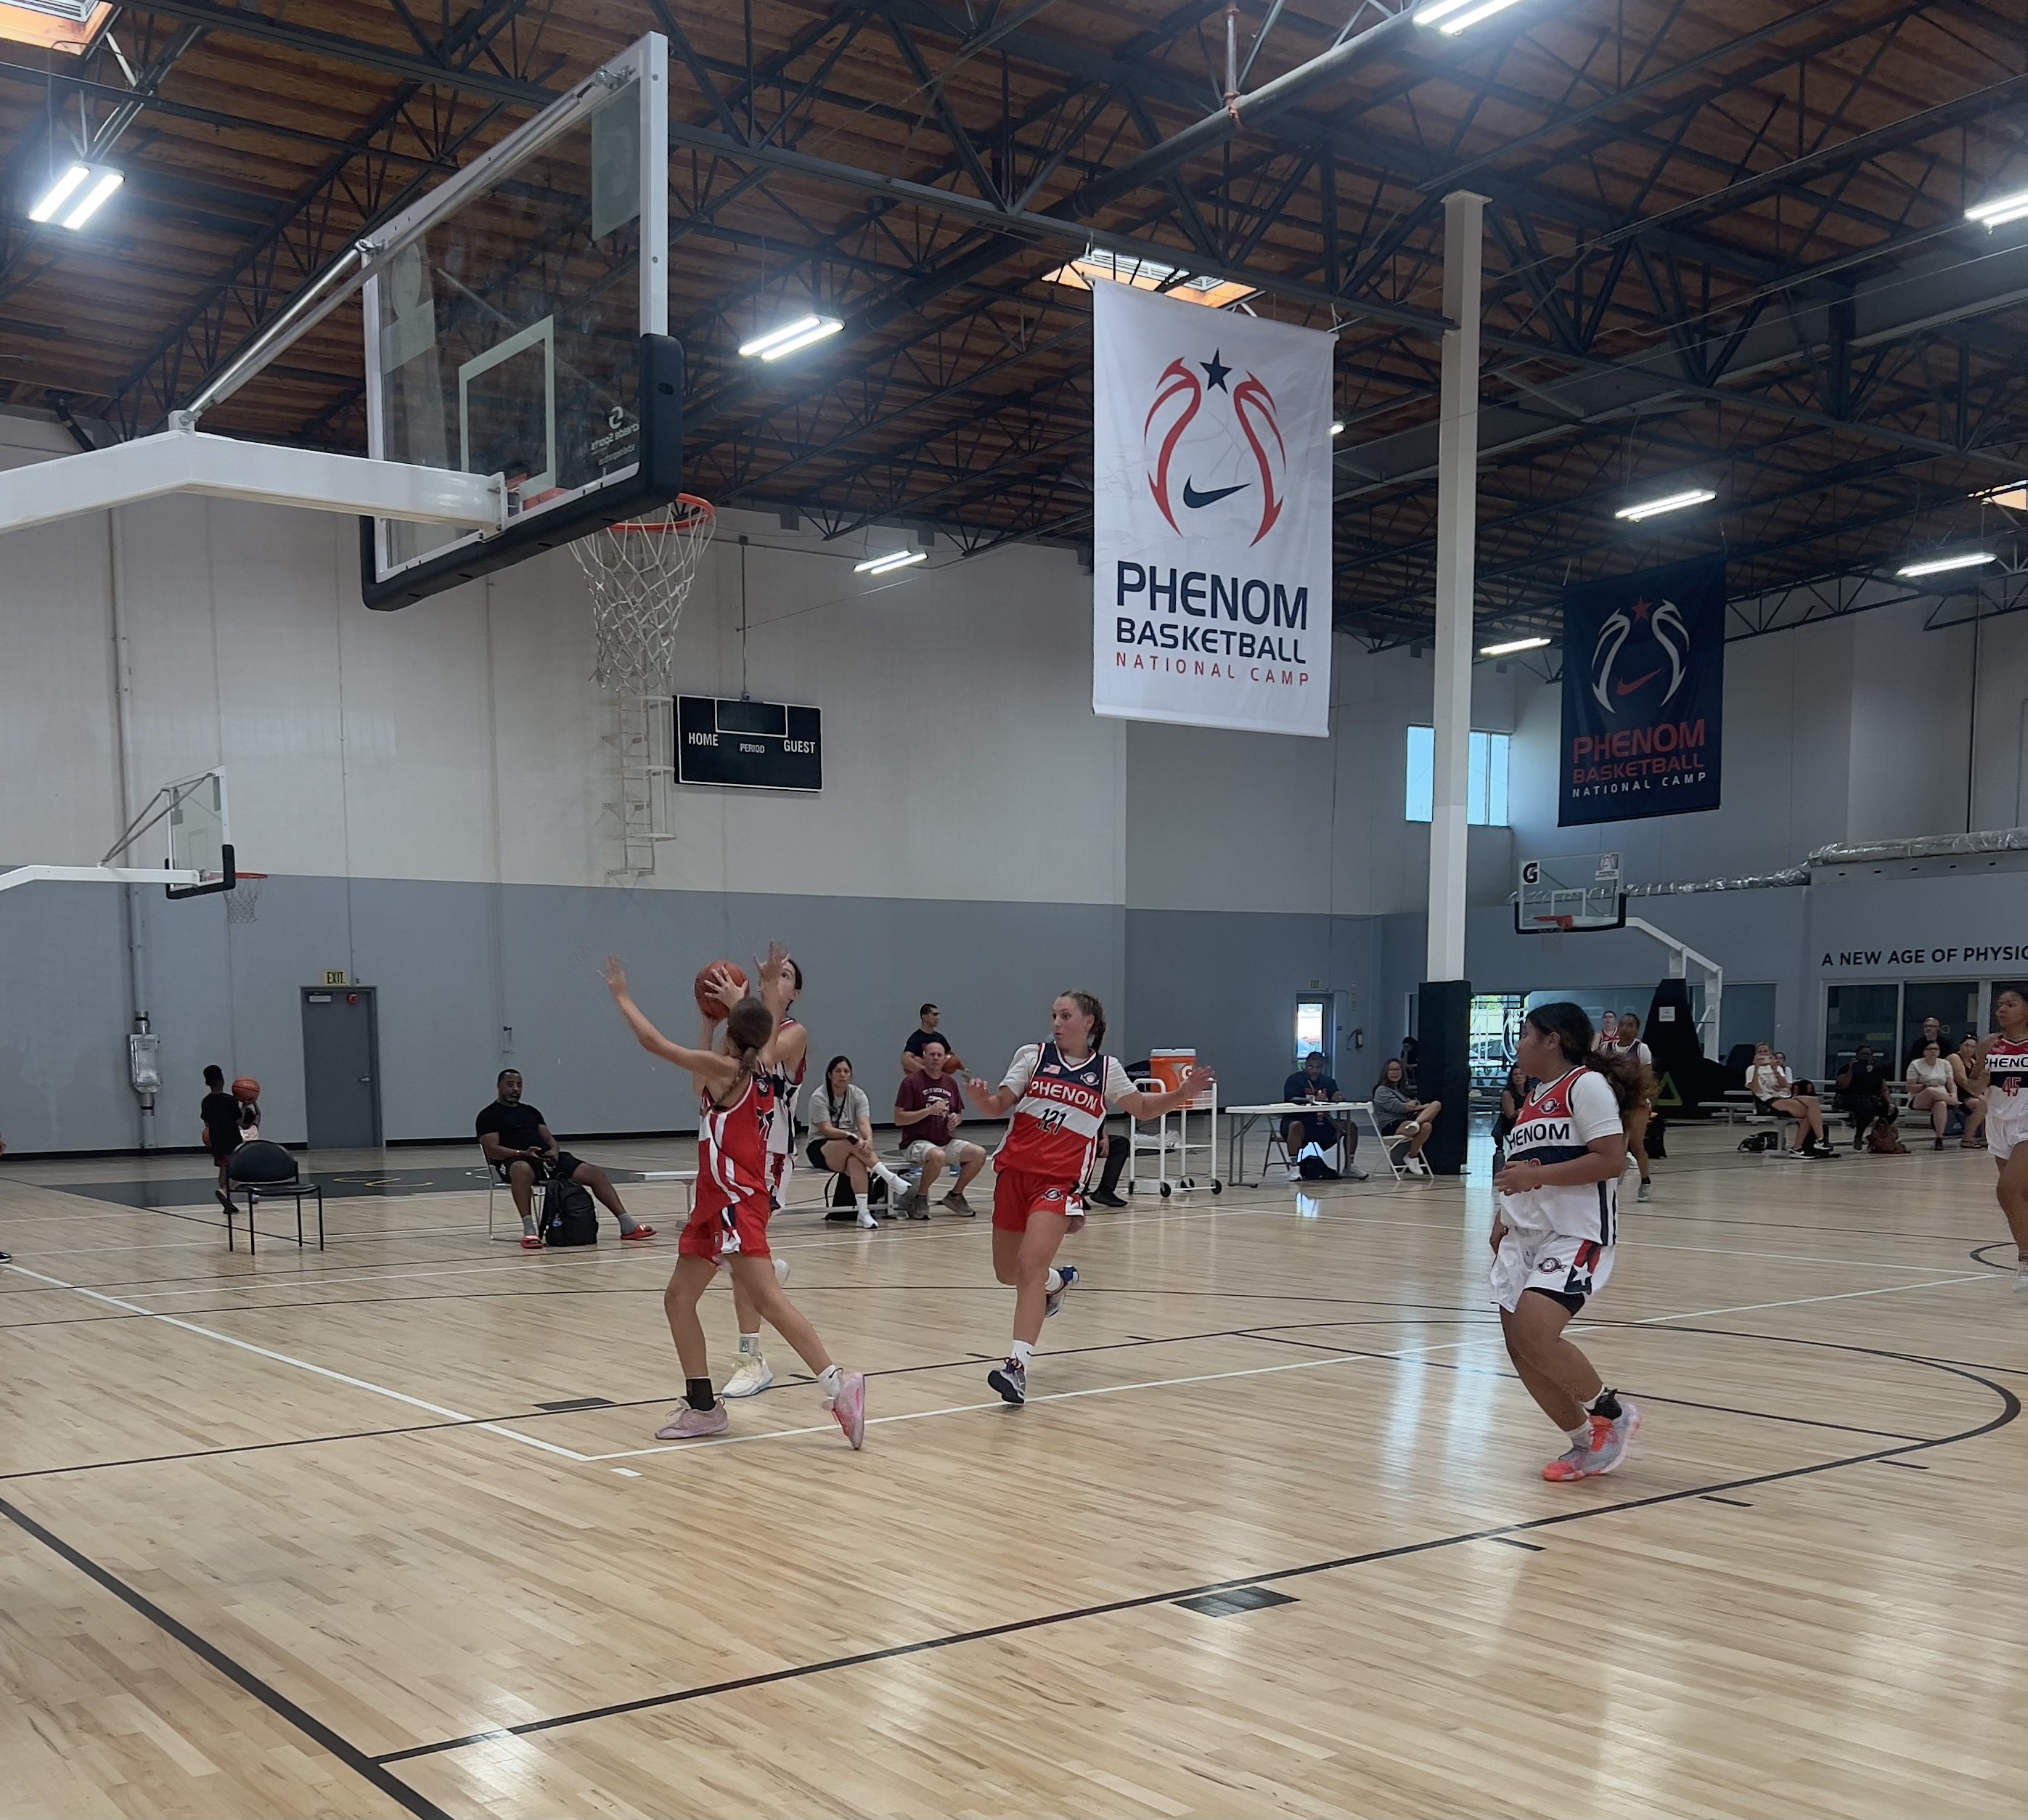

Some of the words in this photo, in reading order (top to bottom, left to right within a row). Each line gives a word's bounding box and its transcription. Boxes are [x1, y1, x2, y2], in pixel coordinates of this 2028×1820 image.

[1116, 560, 1308, 631] PHENOM
[1116, 617, 1307, 664] BASKETBALL
[1116, 652, 1235, 679] NATIONAL
[1250, 666, 1309, 686] CAMP
[688, 732, 719, 747] HOME
[740, 743, 765, 754] PERIOD
[783, 739, 816, 754] GUEST
[1572, 718, 1705, 764] PHENOM
[1572, 752, 1704, 785] BASKETBALL
[1572, 780, 1651, 799] NATIONAL
[1661, 772, 1706, 787] CAMP
[1821, 952, 1833, 966] A
[1839, 951, 1882, 966] NEW
[1887, 950, 1925, 964] AGE
[1931, 948, 1958, 963] OF
[327, 971, 344, 984] EXIT
[1029, 1080, 1098, 1111] PHENOM
[2002, 1076, 2022, 1097] 45
[1037, 1107, 1067, 1135] 121
[1503, 1122, 1569, 1151] HENOM
